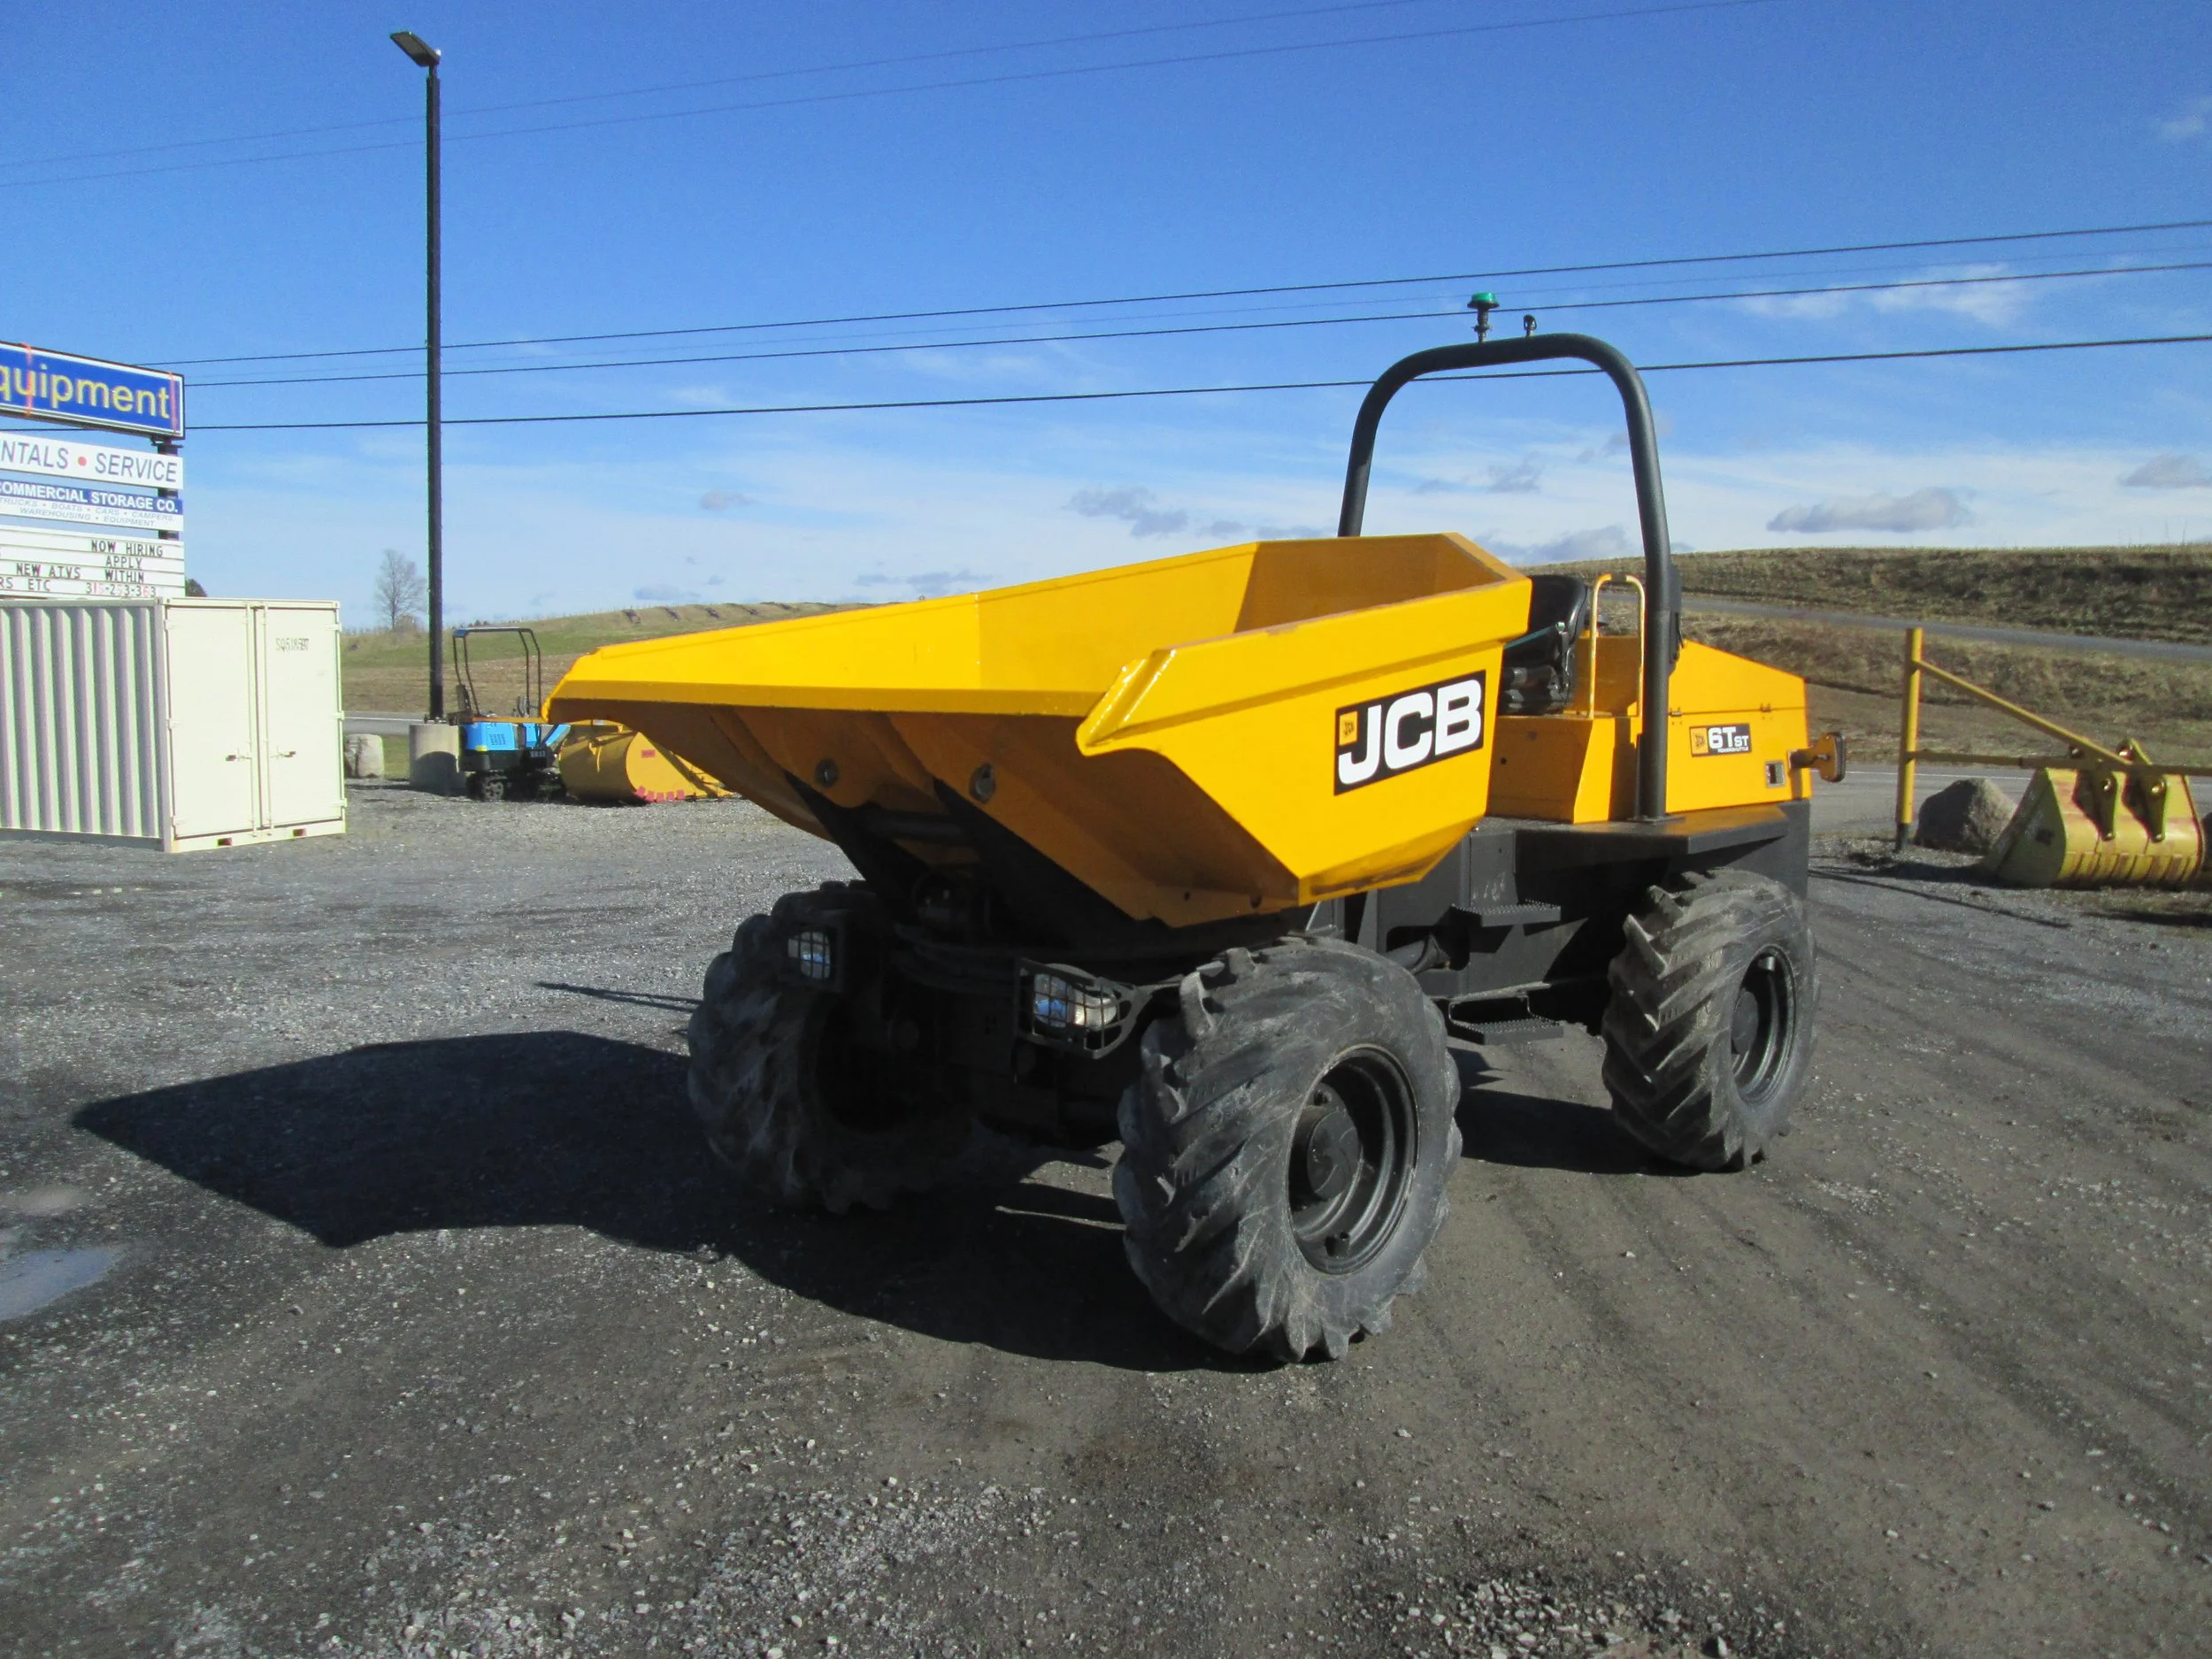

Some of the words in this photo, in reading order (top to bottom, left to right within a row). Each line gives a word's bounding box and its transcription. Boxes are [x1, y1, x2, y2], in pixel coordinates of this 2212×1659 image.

[1, 440, 69, 470] NTALS
[95, 452, 178, 482] SERVICE
[0, 480, 88, 503] OMMERCIAL
[91, 492, 153, 510] STORAGE
[157, 499, 178, 512] CO.
[19, 507, 92, 520] WAREHOUSING
[103, 516, 155, 526] EQUIPMENT
[51, 502, 83, 511] BOATS
[95, 507, 120, 516] CARS
[132, 511, 173, 521] CAMPERS
[91, 539, 116, 553] NOW
[126, 542, 164, 557] HIRING
[16, 562, 41, 577] NEW
[49, 565, 81, 580] ATVS
[106, 555, 142, 569] APPLY
[27, 578, 50, 592] ETC
[104, 569, 144, 584] WITHIN
[1338, 680, 1481, 785] JCB
